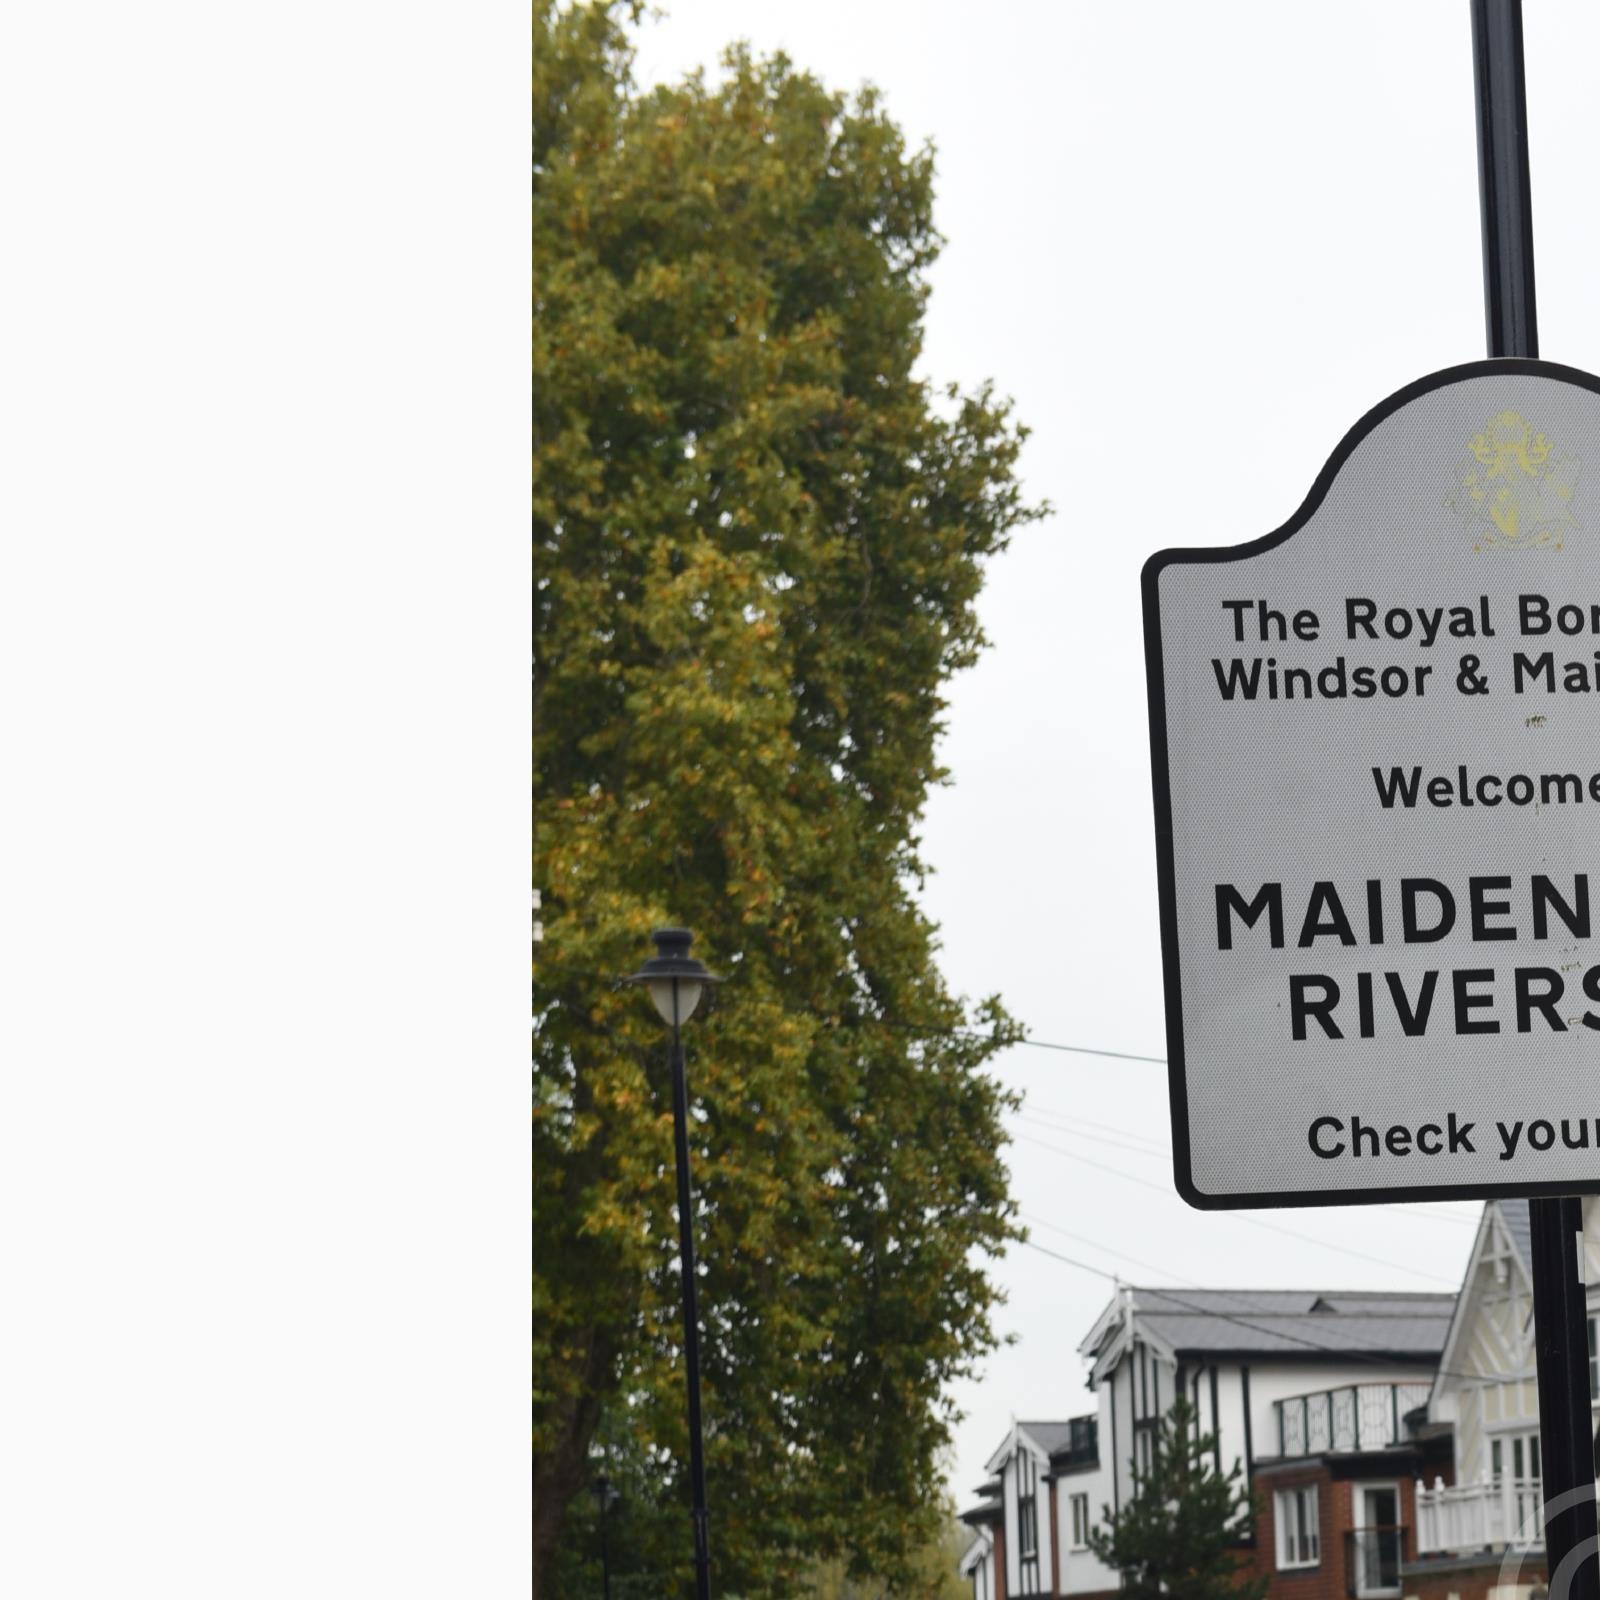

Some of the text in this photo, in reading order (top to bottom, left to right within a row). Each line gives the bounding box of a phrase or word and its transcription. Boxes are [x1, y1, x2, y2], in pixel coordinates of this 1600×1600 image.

[1221, 598, 1321, 643] The
[1345, 596, 1497, 648] Royal
[1210, 655, 1433, 702] Windsor
[1455, 653, 1491, 696] &
[1306, 1112, 1477, 1161] Check
